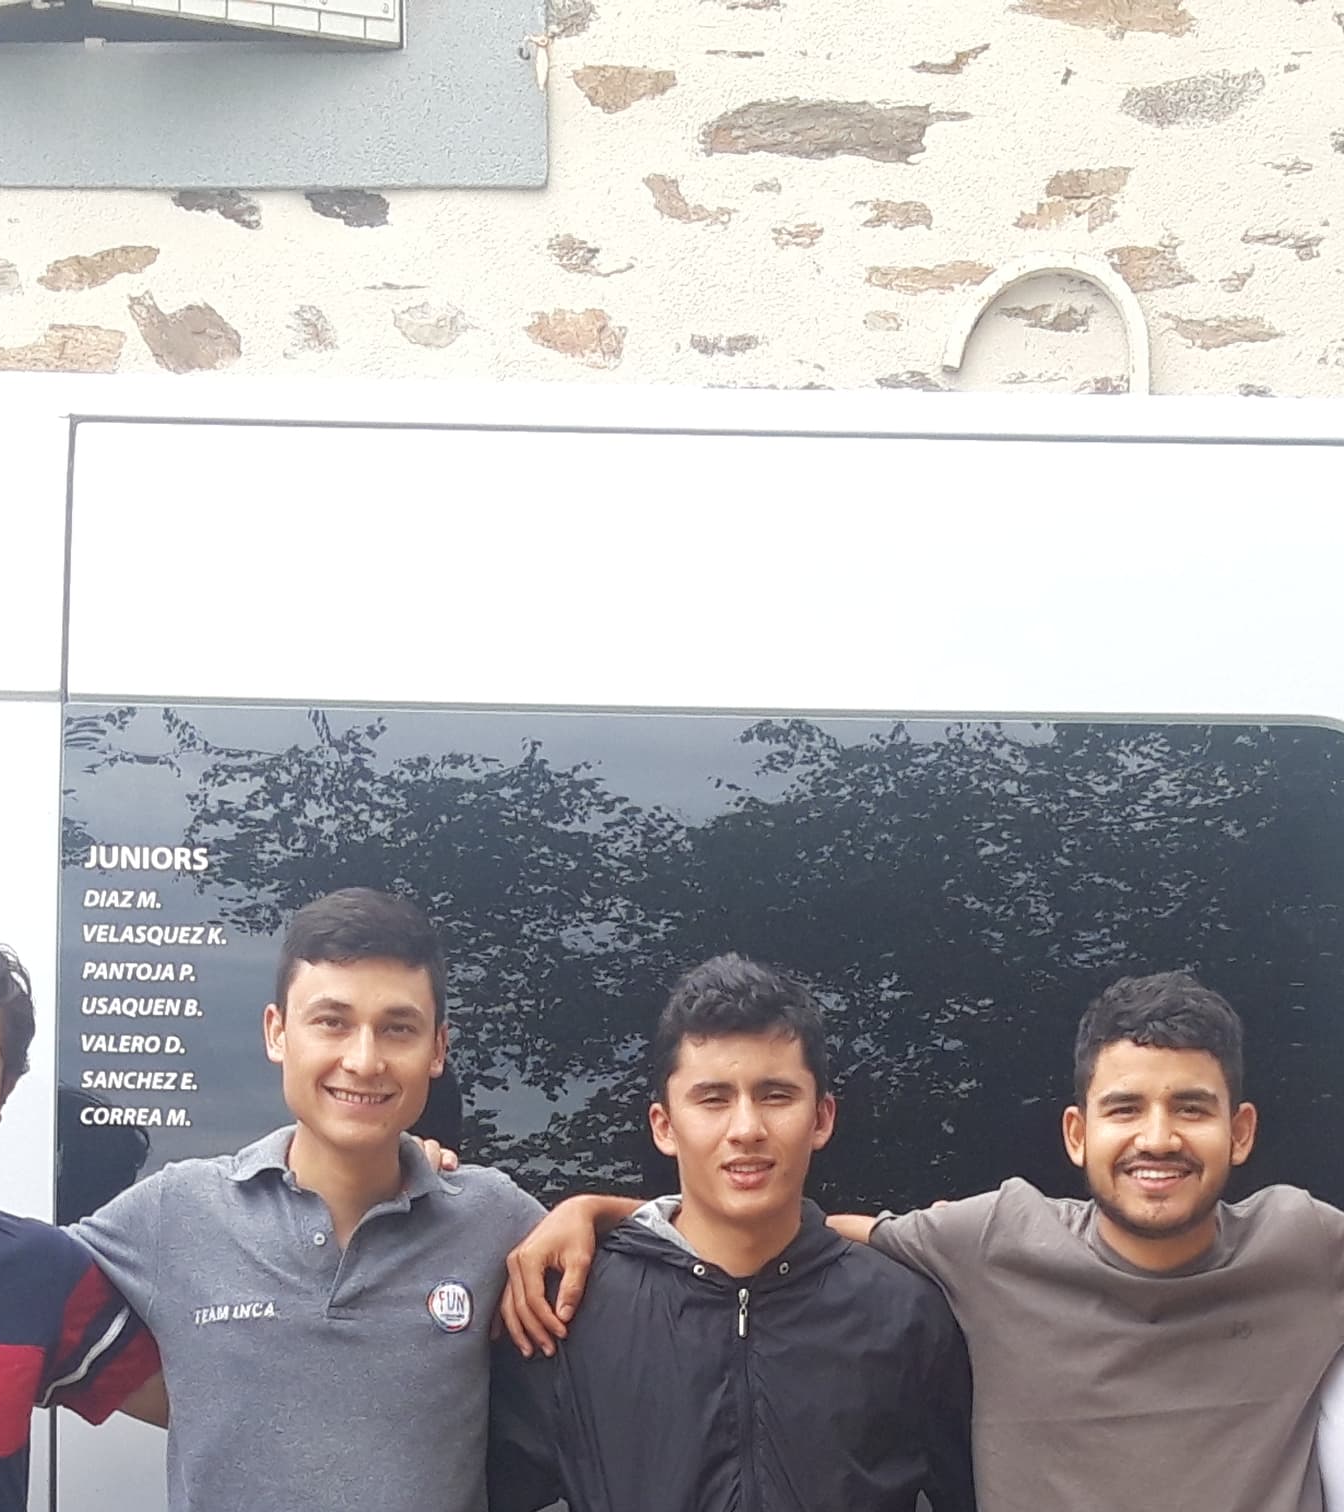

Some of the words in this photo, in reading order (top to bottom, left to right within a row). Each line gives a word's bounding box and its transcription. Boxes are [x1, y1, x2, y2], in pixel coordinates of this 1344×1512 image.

[84, 845, 209, 871] JUNIORS
[83, 889, 134, 908] DIAZ
[136, 891, 162, 909] M.
[82, 924, 204, 946] VELASQUEZ
[207, 927, 227, 945] K.
[81, 961, 175, 982] PANTOJA
[178, 963, 196, 982] P.
[81, 997, 181, 1018] USAQUEN
[183, 998, 203, 1017] B.
[80, 1034, 161, 1053] VALERO
[163, 1036, 185, 1054] D.
[80, 1070, 177, 1090] SANCHEZ
[180, 1072, 198, 1090] E.
[80, 1107, 162, 1126] CORREA
[165, 1109, 192, 1127] M.
[194, 1305, 230, 1325] TEAM
